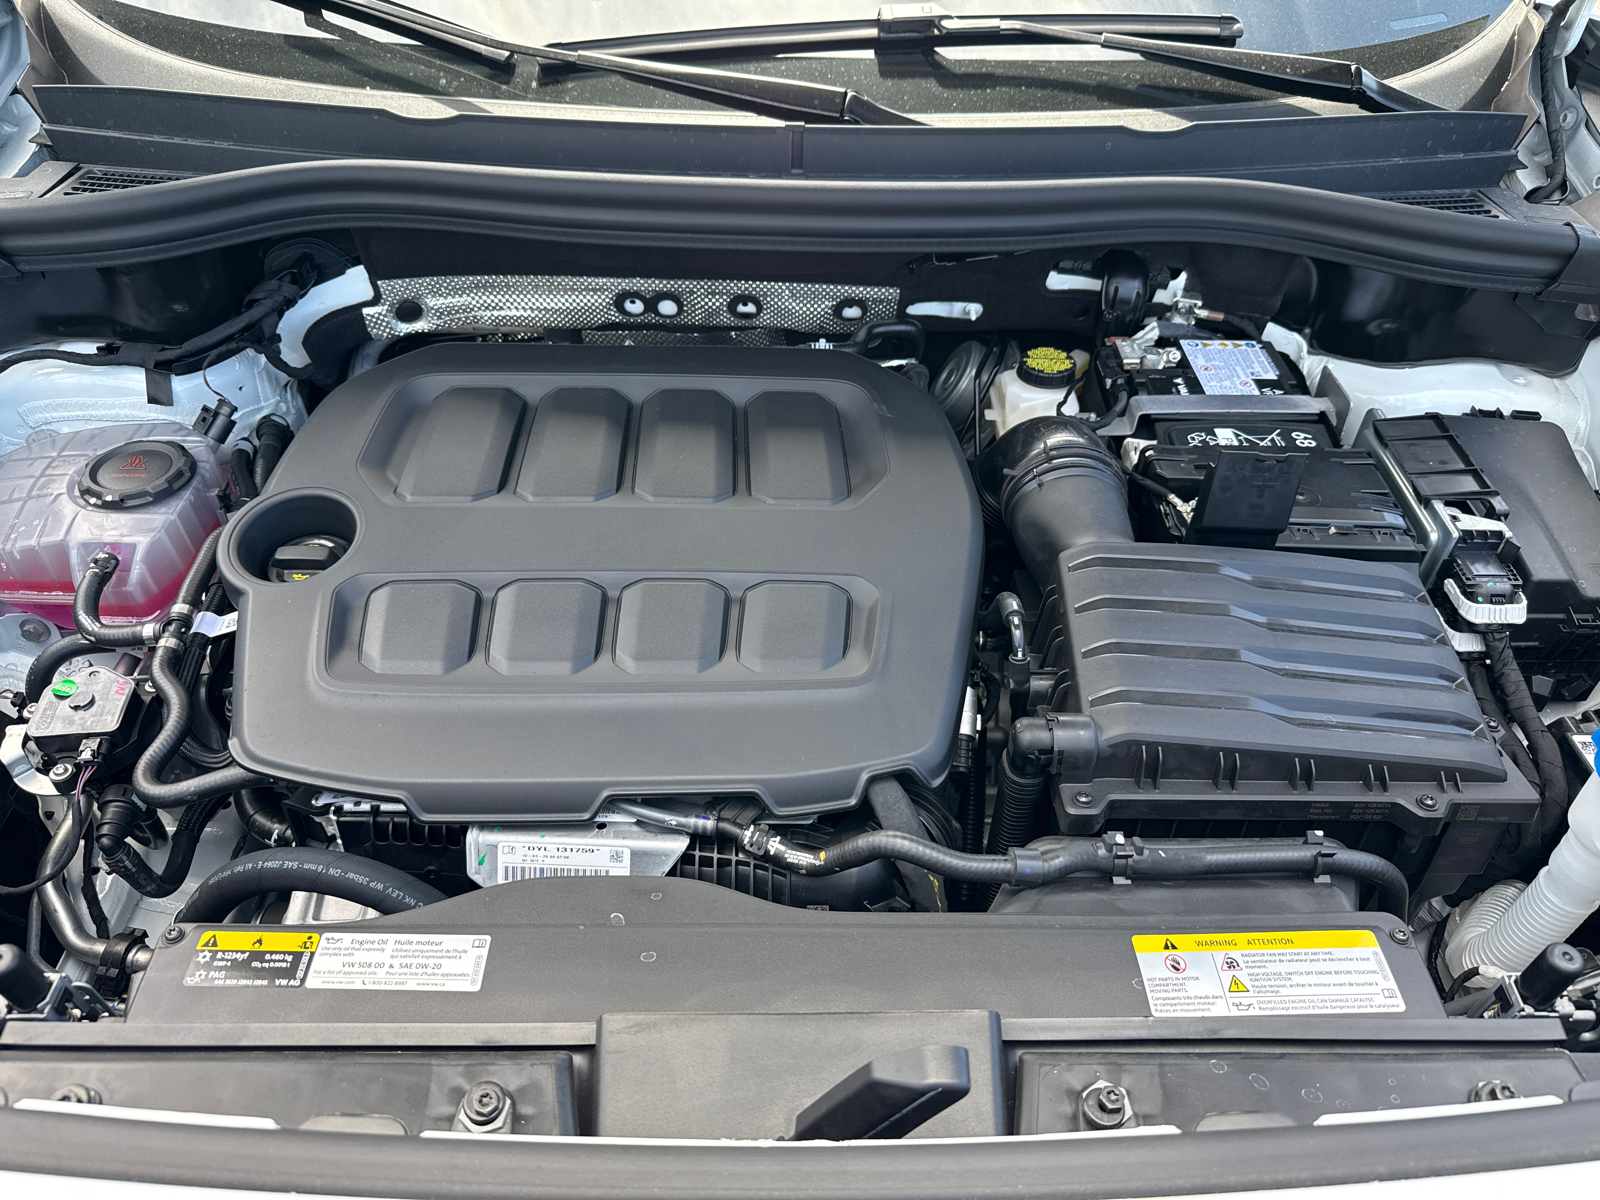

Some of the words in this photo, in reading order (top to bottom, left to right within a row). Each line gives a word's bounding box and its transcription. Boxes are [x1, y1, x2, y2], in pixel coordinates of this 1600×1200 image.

[1290, 432, 1317, 448] 68
[283, 861, 298, 869] SAE
[328, 867, 341, 876] DN
[345, 872, 369, 885] 35bar
[370, 881, 384, 891] WP
[386, 887, 404, 900] LEV
[216, 952, 250, 961] R-1234yf
